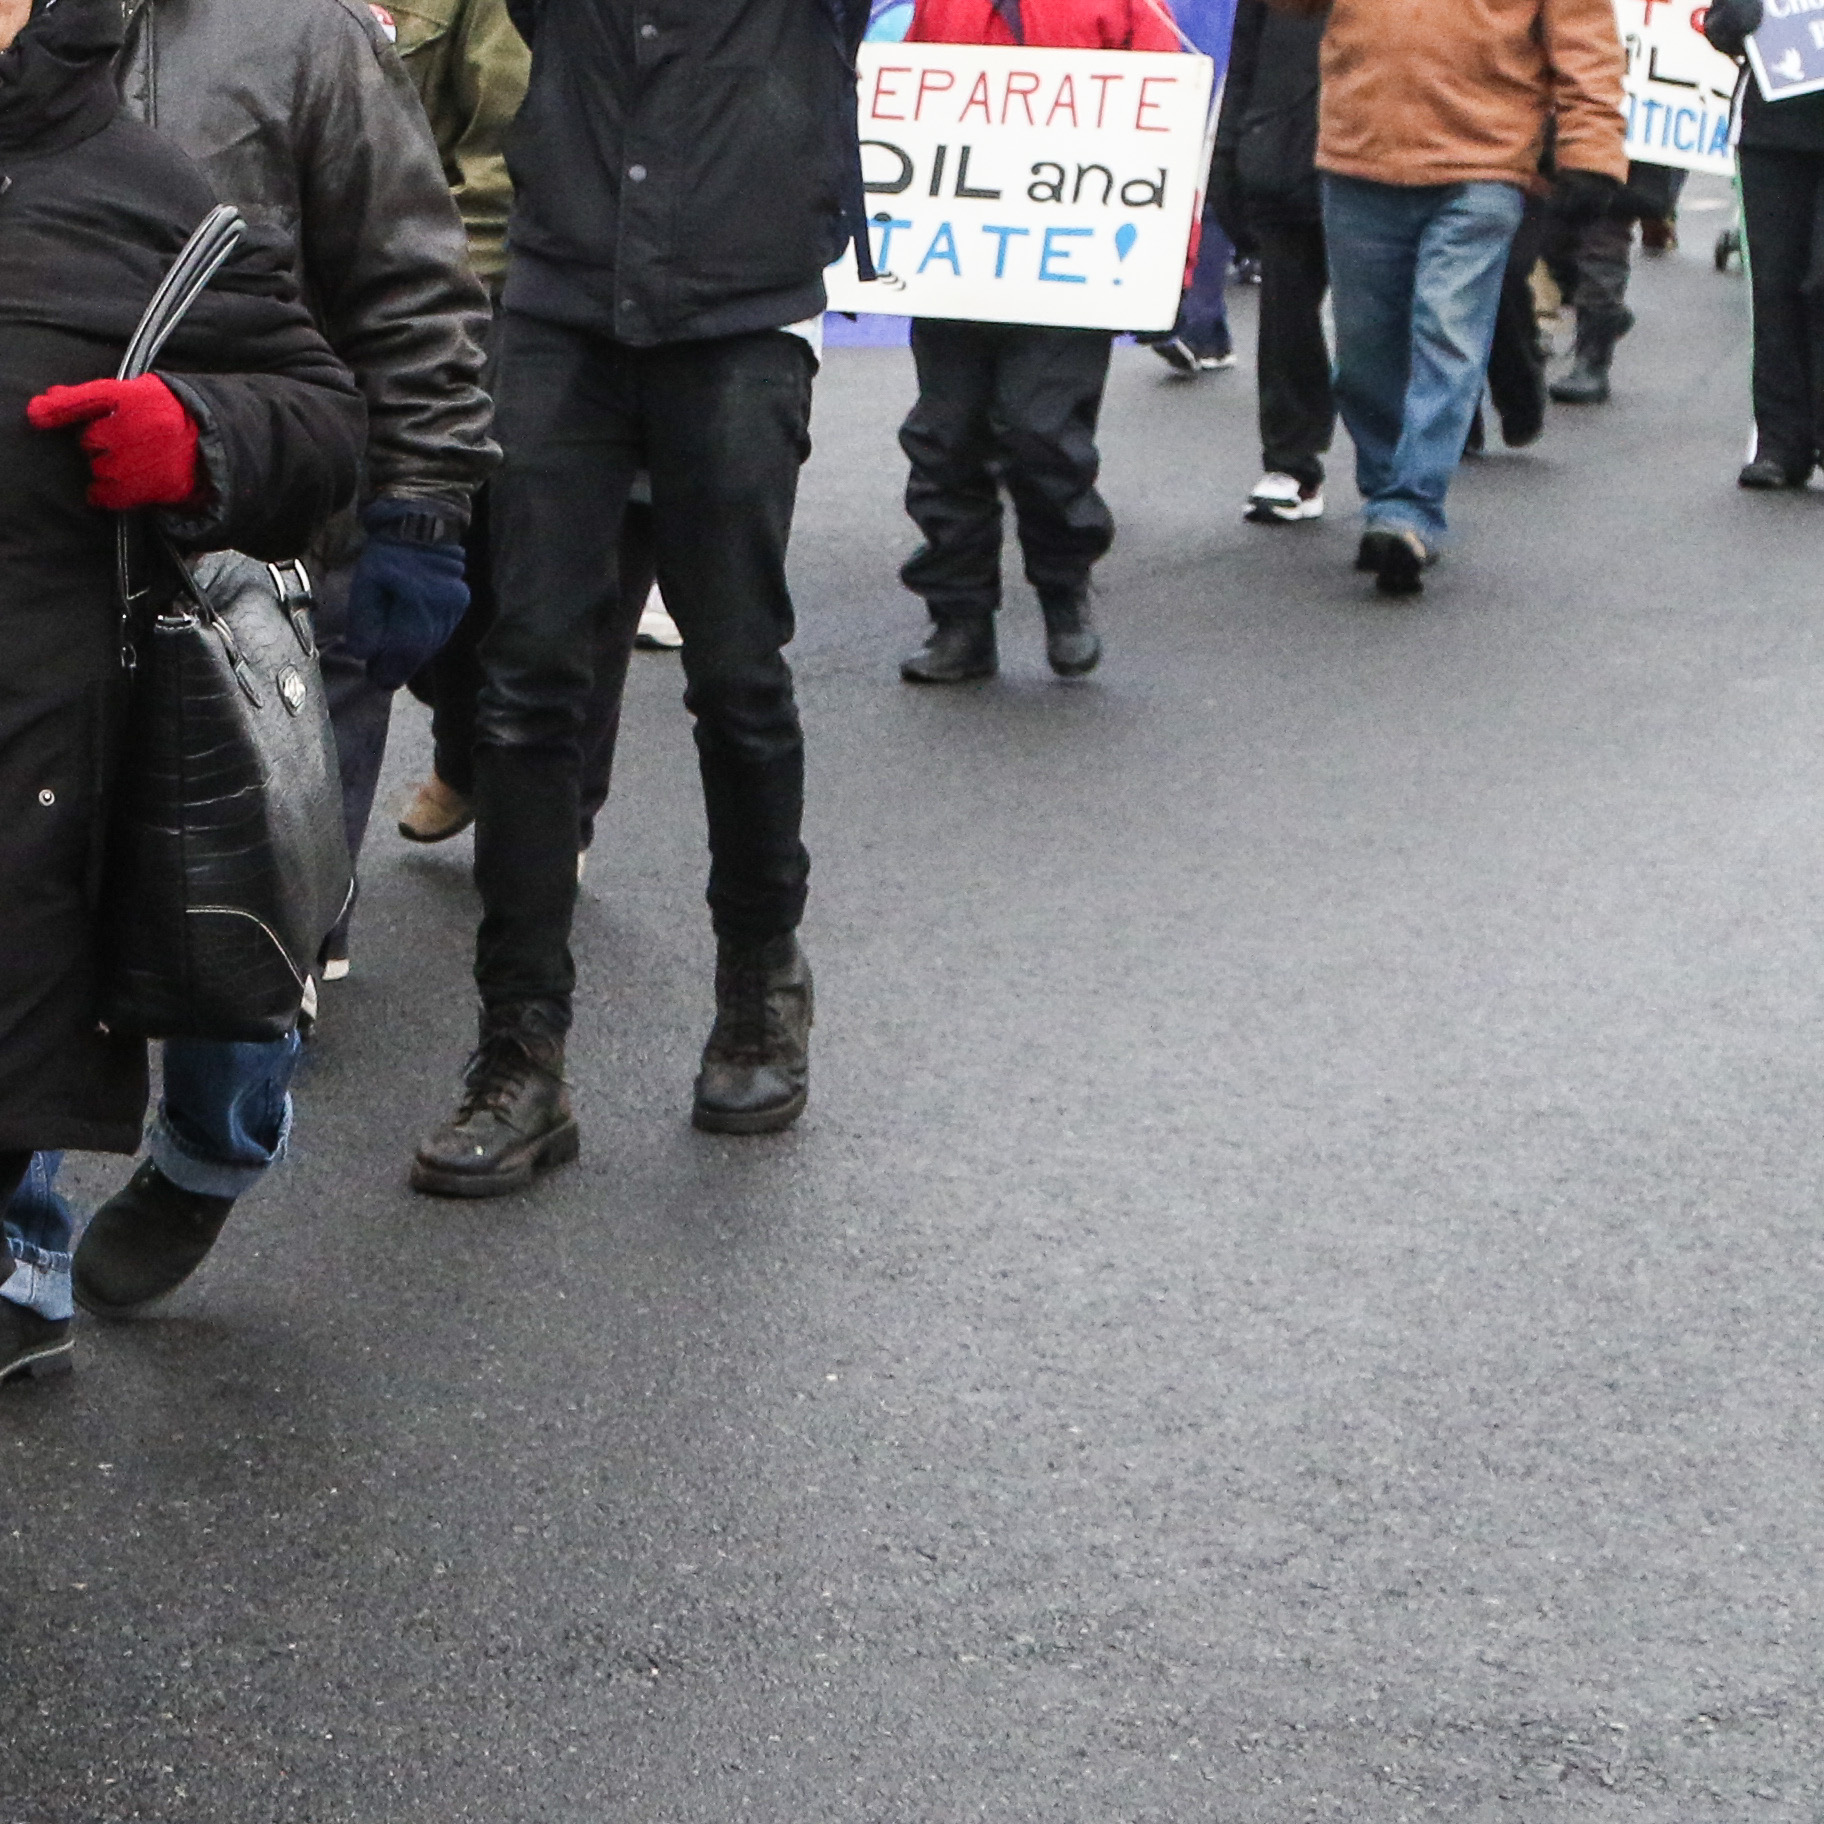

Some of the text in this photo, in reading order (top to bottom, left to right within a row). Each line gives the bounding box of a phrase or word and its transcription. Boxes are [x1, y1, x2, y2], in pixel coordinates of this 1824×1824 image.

[858, 66, 1179, 132] EPARATE
[1027, 160, 1168, 210] and
[866, 217, 1140, 287] TATE!
